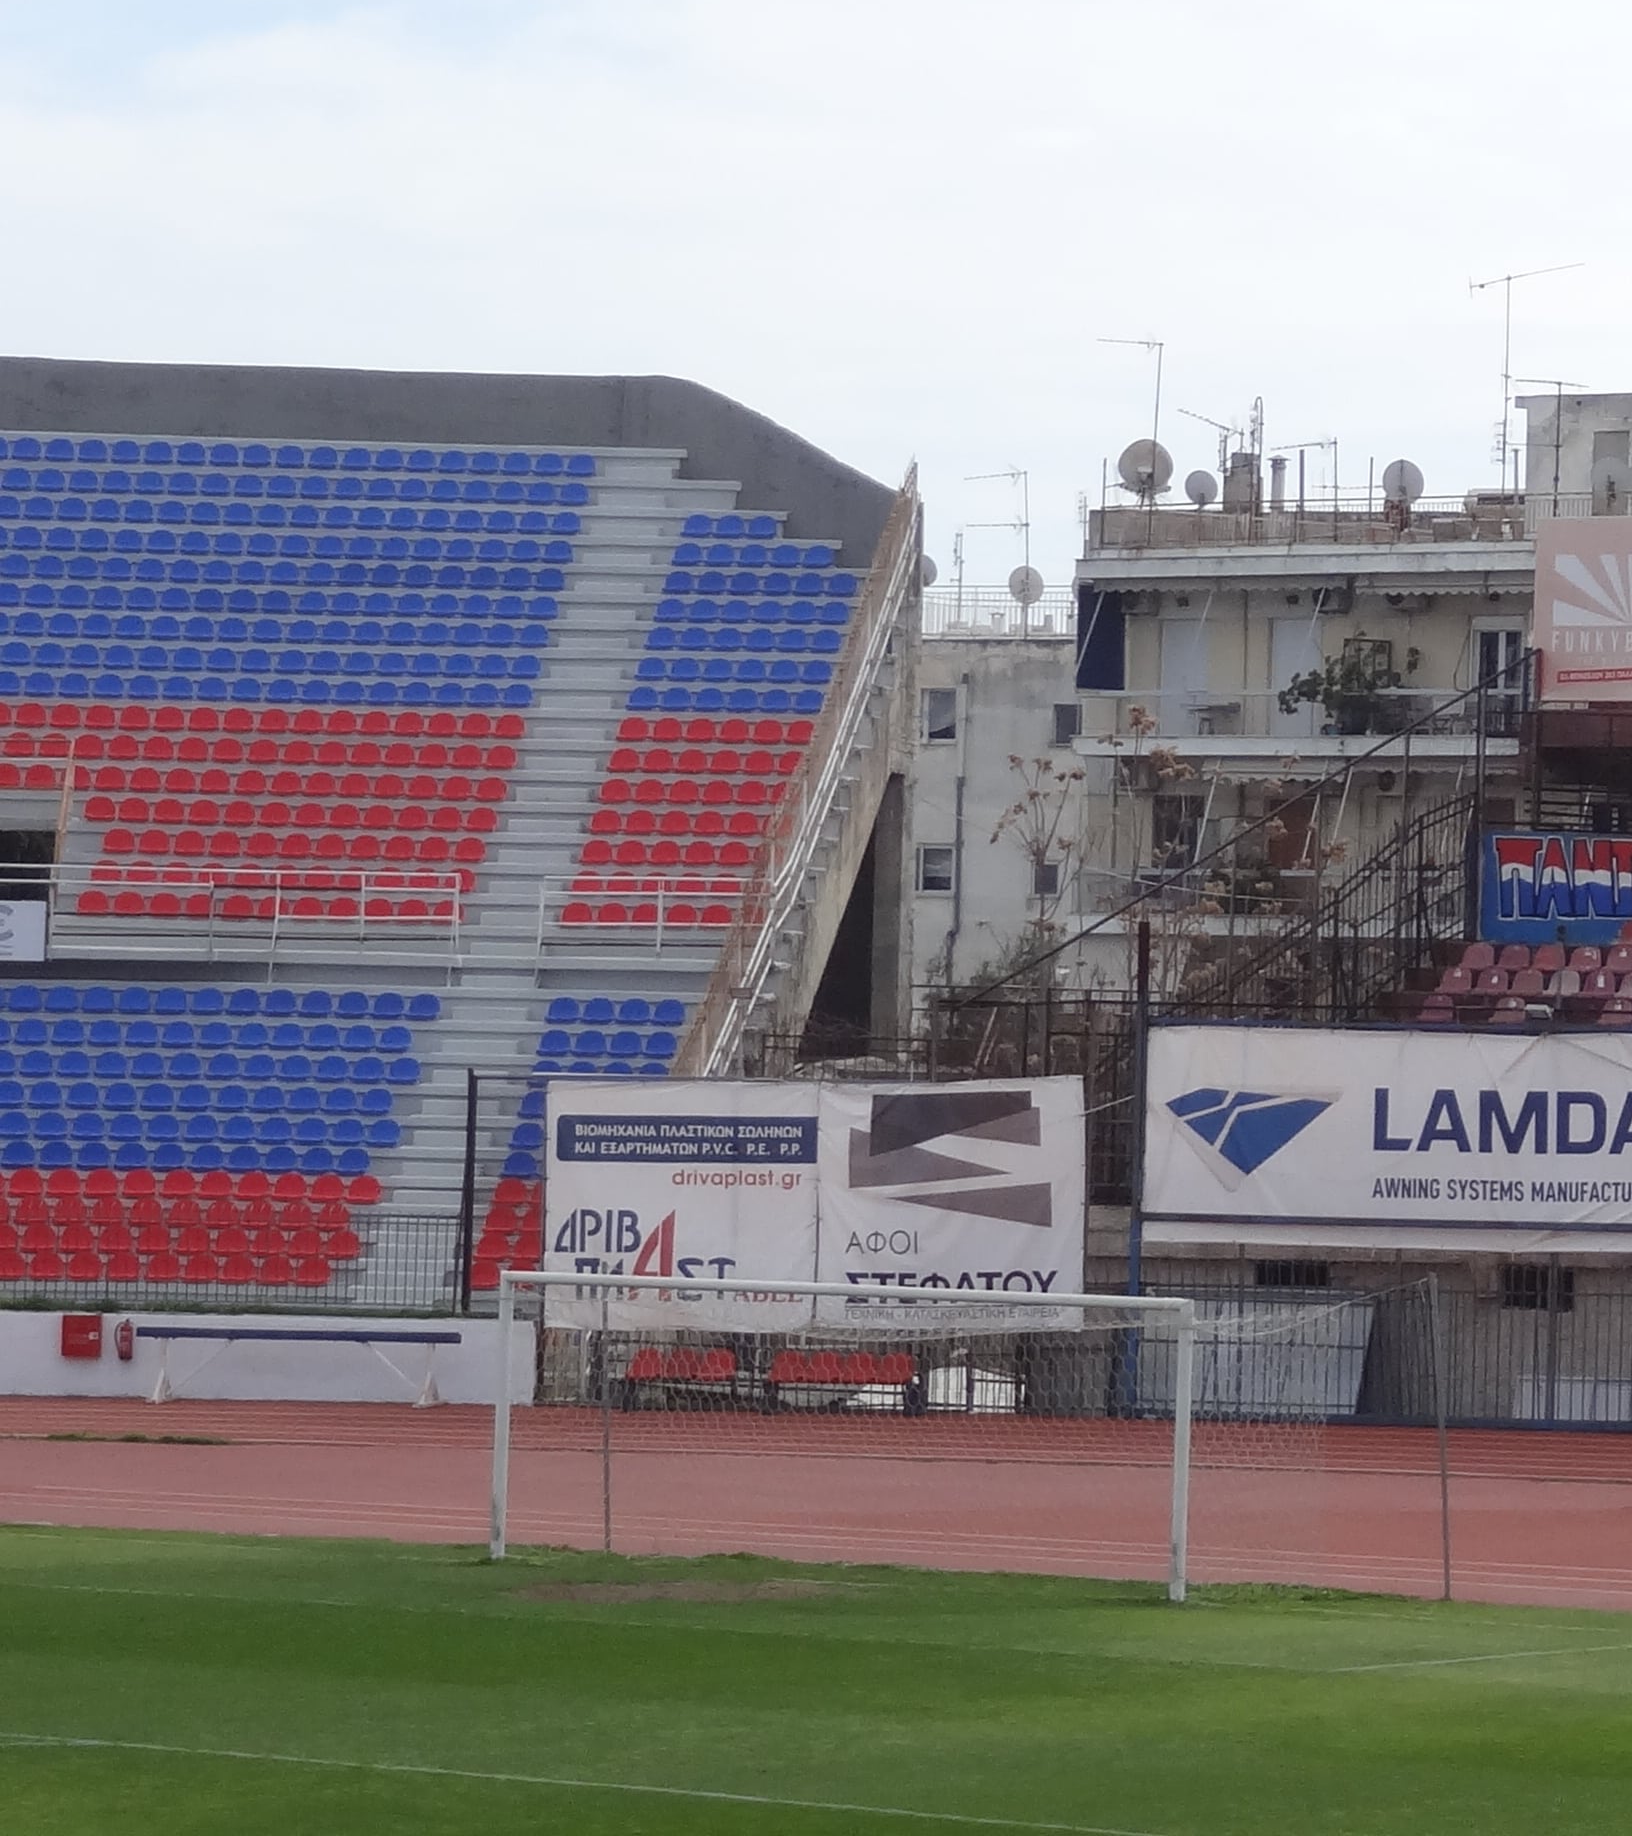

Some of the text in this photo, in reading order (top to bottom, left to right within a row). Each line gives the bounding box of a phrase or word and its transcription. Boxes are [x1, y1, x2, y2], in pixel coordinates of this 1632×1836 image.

[574, 1123, 803, 1139] ΒΙΟΜΗΧΑΝΙΑ ΠΛΑΣΤΙΚΩΝ ΣΩΛΗΝΩΝ
[574, 1141, 596, 1155] ΚΑΙ
[600, 1141, 699, 1156] ΕΞΑΡΤΗΜΑΤΩΝ
[671, 1169, 803, 1190] drivaplast.gr
[1371, 1177, 1441, 1200] AWNING
[1446, 1179, 1524, 1202] SYSTEMS
[845, 1230, 920, 1255] ΑΦΟΙ
